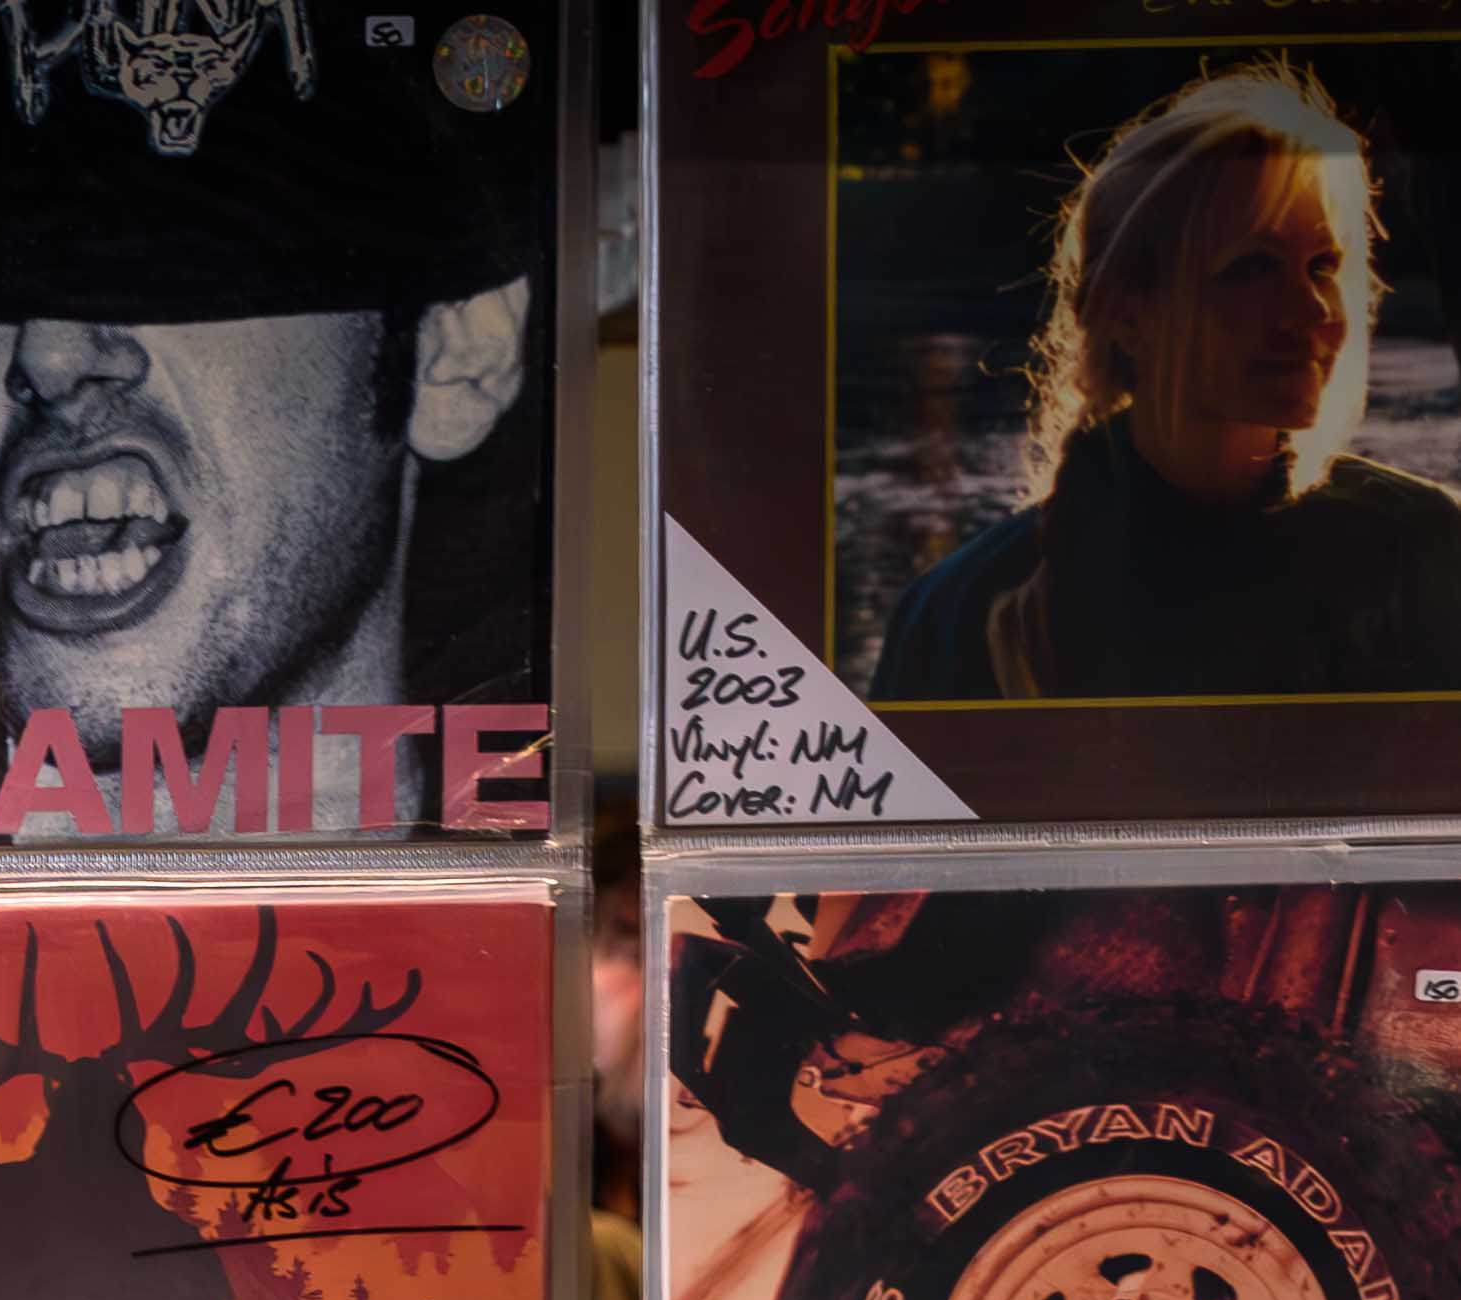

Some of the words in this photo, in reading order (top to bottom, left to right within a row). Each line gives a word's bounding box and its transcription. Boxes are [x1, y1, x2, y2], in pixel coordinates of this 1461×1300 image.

[678, 607, 768, 662] U.S.
[679, 665, 806, 711] 2003
[789, 720, 869, 765] NM
[808, 766, 895, 817] NM
[925, 1102, 1216, 1232] BRYAN
